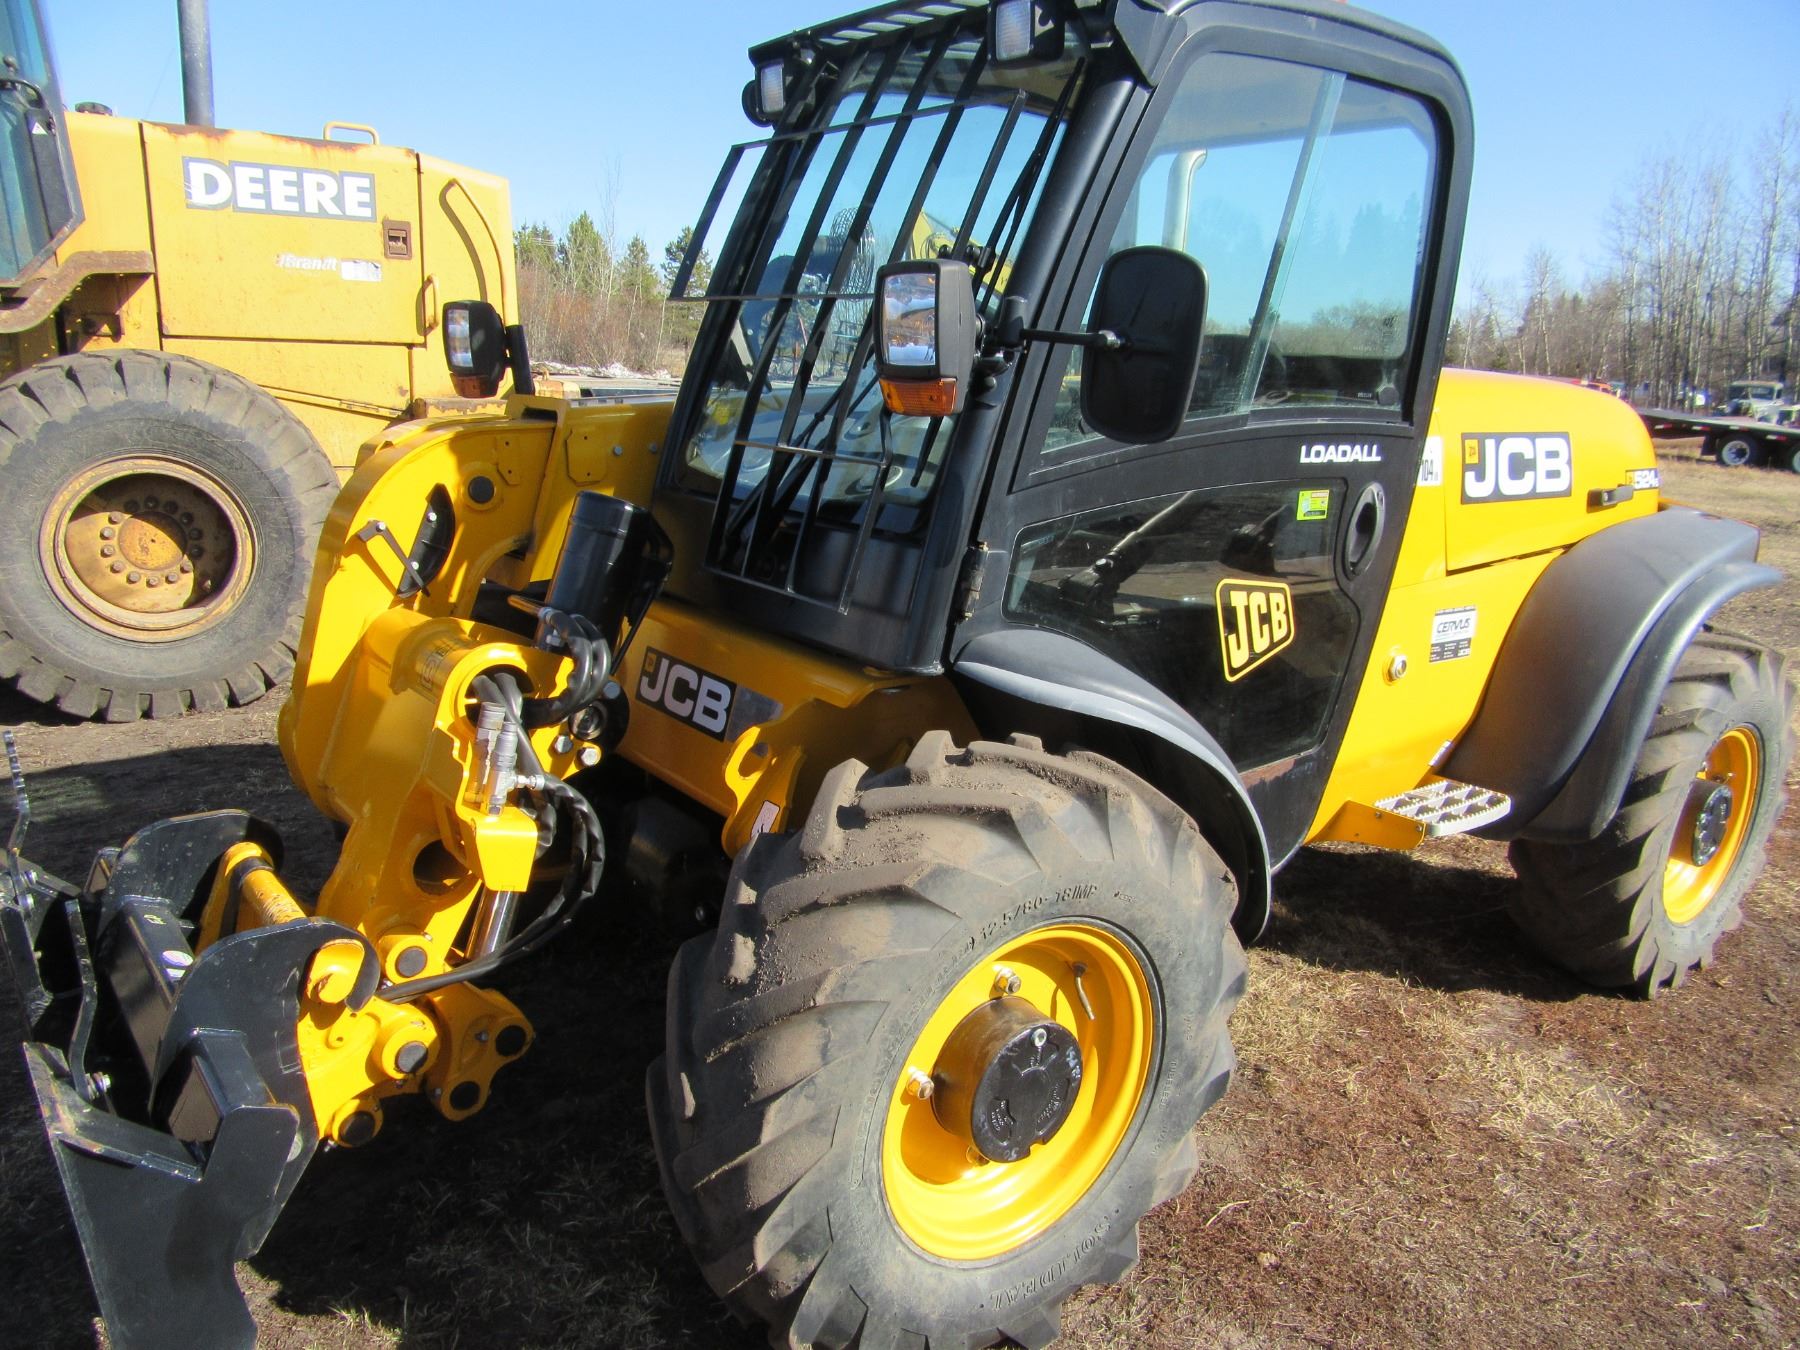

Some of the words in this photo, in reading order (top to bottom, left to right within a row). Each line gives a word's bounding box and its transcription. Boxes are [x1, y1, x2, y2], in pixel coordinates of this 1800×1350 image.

[188, 162, 372, 218] DEERE
[1300, 444, 1382, 464] LOADALL
[1464, 437, 1571, 498] JCB
[1227, 590, 1288, 669] JCB
[639, 657, 732, 734] JCB
